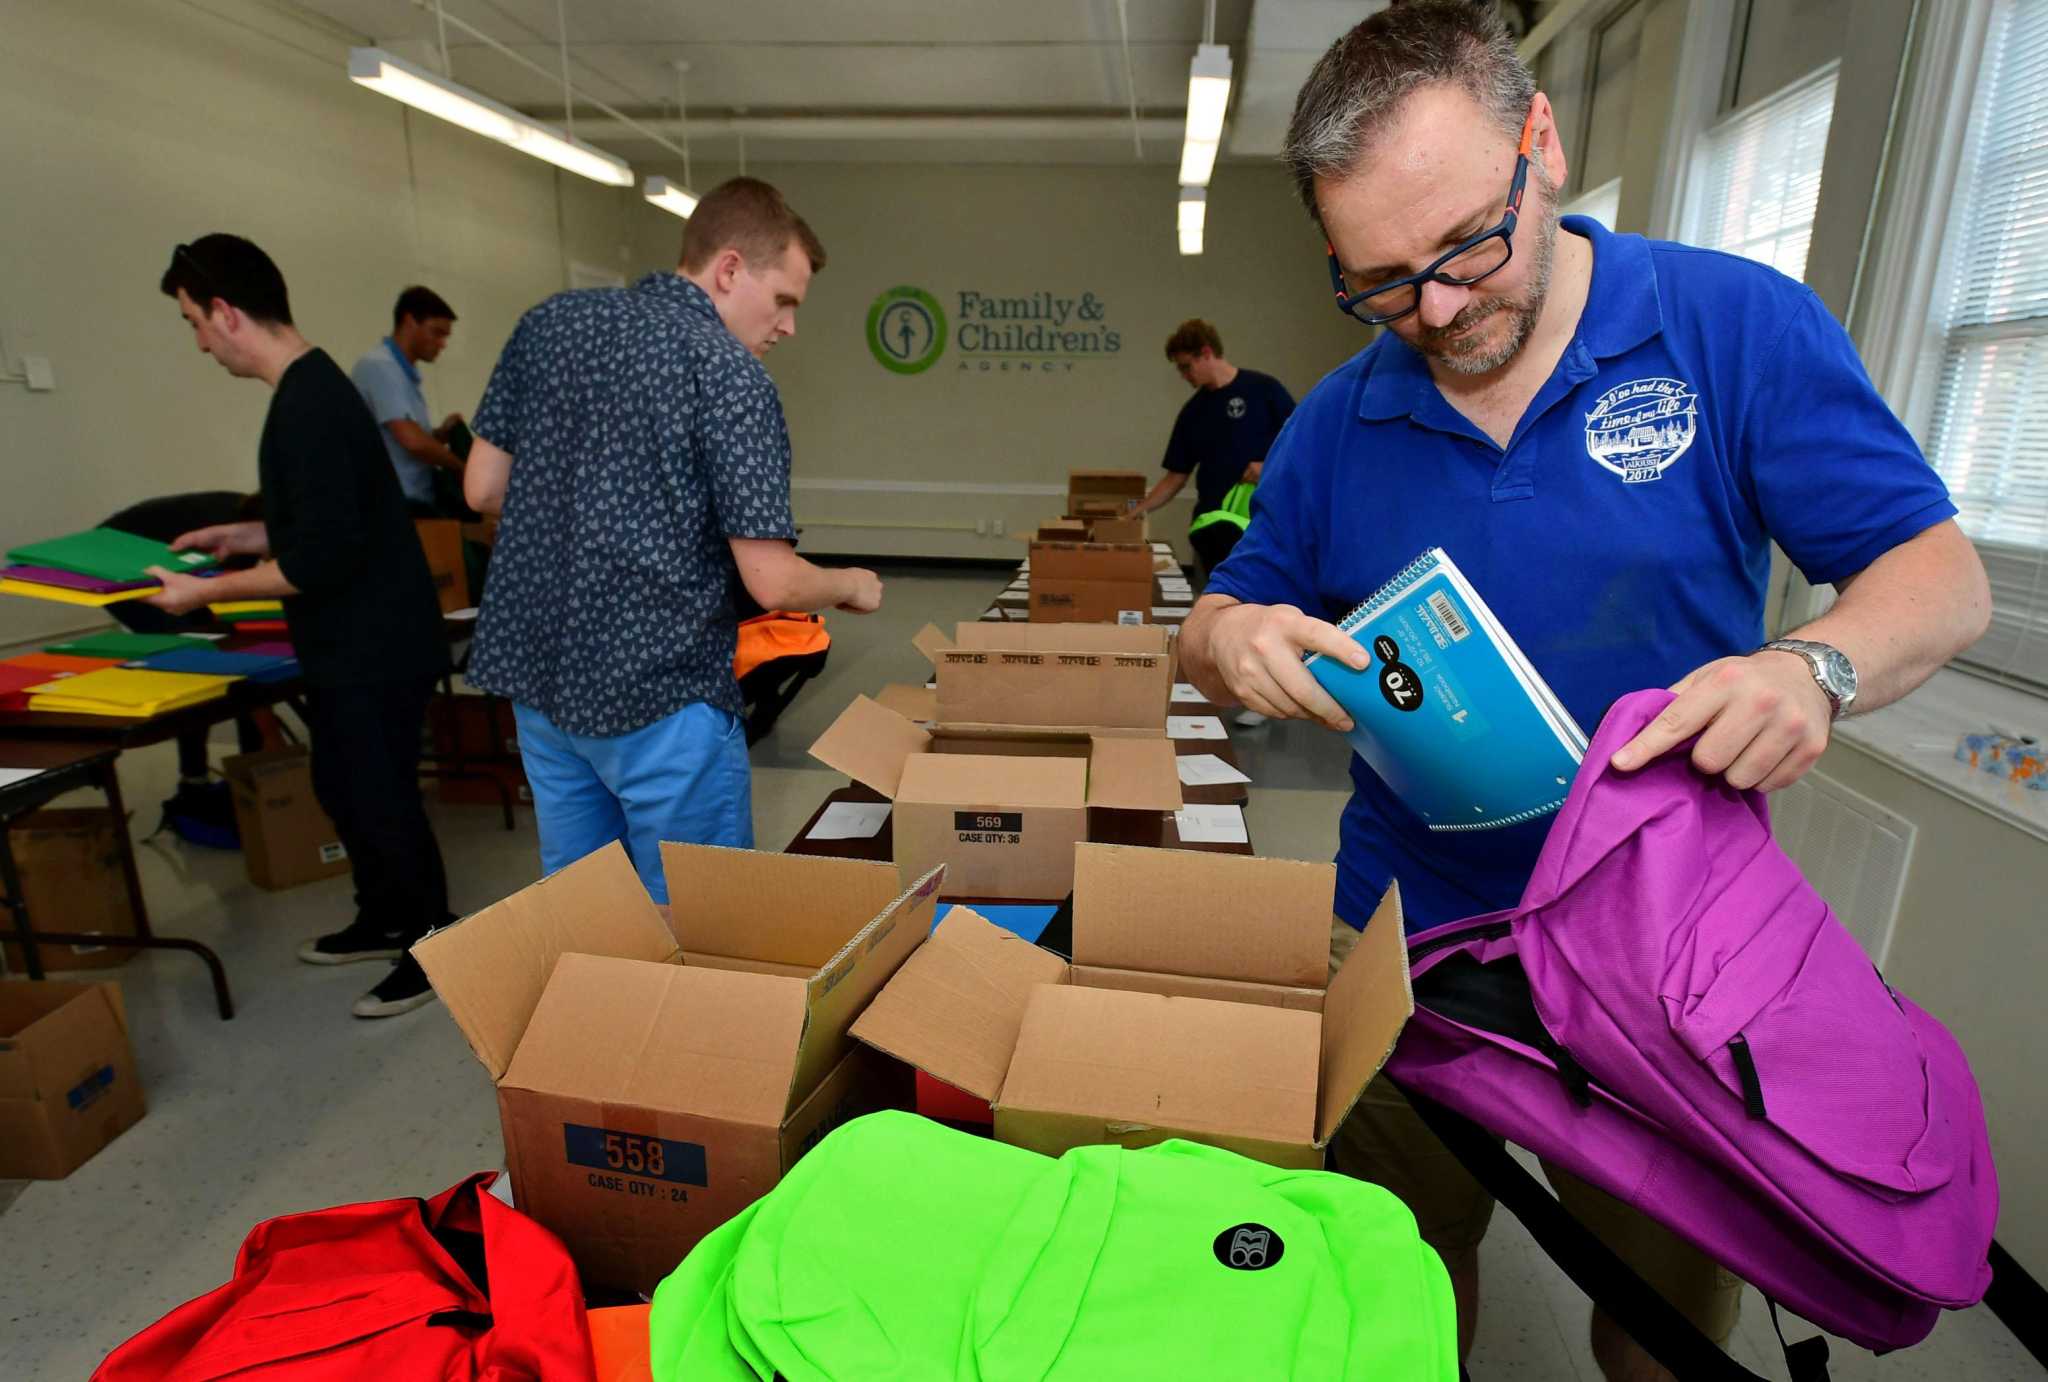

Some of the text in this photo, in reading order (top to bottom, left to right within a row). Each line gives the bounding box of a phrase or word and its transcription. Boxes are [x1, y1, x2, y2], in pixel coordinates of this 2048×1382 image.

[957, 291, 1074, 326] Family
[957, 324, 1121, 351] Children's
[958, 361, 1074, 371] AGENCY
[1632, 381, 1656, 395] had
[1655, 382, 1675, 394] the
[1601, 414, 1631, 429] time
[1656, 399, 1680, 416] life
[1626, 459, 1657, 469] AUGUST
[1627, 468, 1655, 480] 2017
[1386, 672, 1412, 705] 70
[976, 815, 1002, 829] 569
[958, 832, 1020, 845] CASE QTY: 36
[605, 1134, 666, 1177] 558
[588, 1173, 624, 1192] CASE
[671, 1190, 688, 1203] 24
